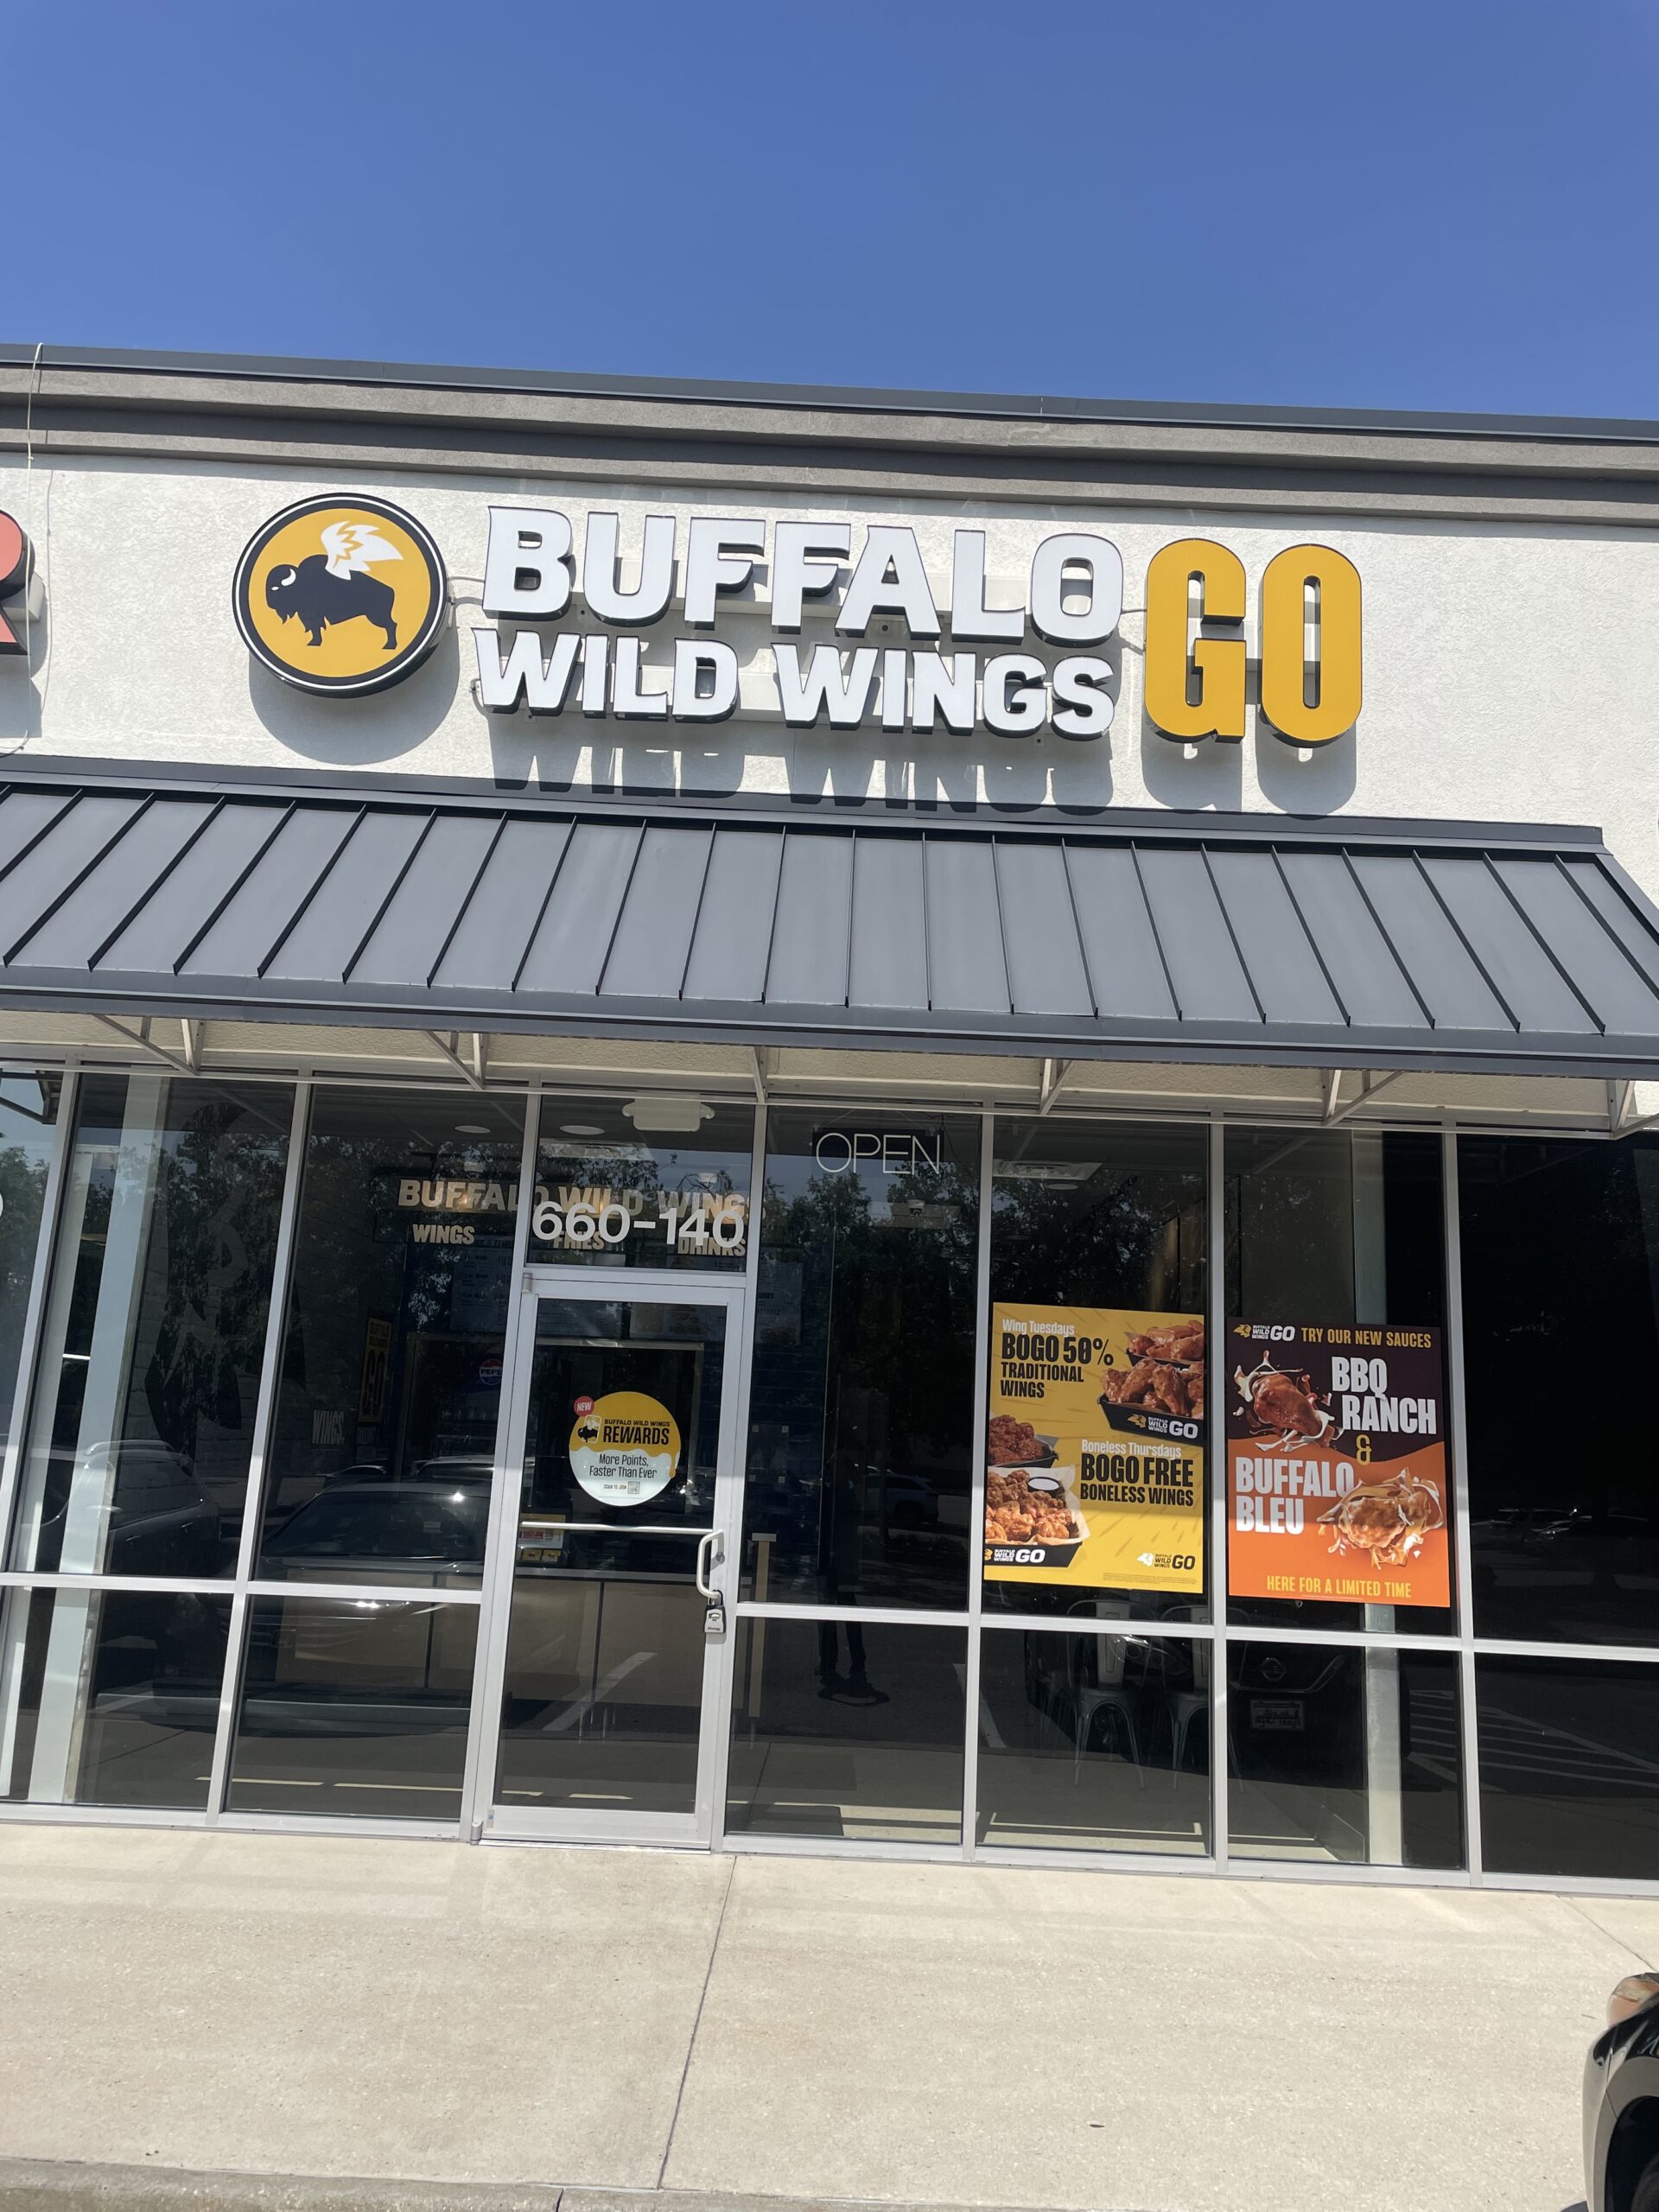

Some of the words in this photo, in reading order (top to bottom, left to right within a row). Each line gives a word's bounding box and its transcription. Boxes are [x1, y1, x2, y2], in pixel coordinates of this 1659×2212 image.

[482, 505, 1123, 646] BUFFALO
[1145, 537, 1363, 747] GO
[471, 628, 738, 722] WILD
[772, 643, 1115, 741] WINGS
[816, 1133, 940, 1175] OPEN
[657, 1190, 766, 1220] WING
[413, 1224, 475, 1244] WINGS
[532, 1201, 744, 1249] 660-140
[1002, 1319, 1027, 1335] Wing
[1029, 1321, 1075, 1337] Tuesdays
[1270, 1325, 1295, 1341] GO
[1301, 1327, 1323, 1343] TRY
[1327, 1329, 1351, 1344] OUR
[1356, 1331, 1382, 1345] NEW
[1386, 1332, 1431, 1348] SAUCES
[1002, 1332, 1058, 1362] BOGO
[1064, 1337, 1114, 1365] 50%
[1001, 1362, 1084, 1382] TRADITIONAL
[1332, 1357, 1388, 1401] BBQ
[1001, 1380, 1045, 1398] WINGS
[577, 1402, 593, 1411] NEW
[1342, 1395, 1437, 1434] RANCH
[603, 1426, 670, 1445] REWARDS
[1169, 1421, 1198, 1439] GO
[600, 1453, 620, 1465] More
[622, 1455, 649, 1466] Points,
[1082, 1439, 1126, 1454] Boneless
[1128, 1442, 1182, 1460] Thursdays
[1357, 1434, 1372, 1465] &
[589, 1465, 616, 1477] Faster
[619, 1467, 638, 1478] Than
[639, 1468, 657, 1478] Ever
[1081, 1453, 1139, 1484] BOGO
[1143, 1457, 1193, 1487] FREE
[1236, 1457, 1354, 1497] BUFFALO
[1080, 1483, 1145, 1503] BONELESS
[1148, 1487, 1193, 1506] WINGS
[1236, 1496, 1304, 1535] BLEU
[1015, 1548, 1046, 1563] GO
[1173, 1554, 1196, 1570] GO
[1267, 1575, 1295, 1592] HERE
[1300, 1577, 1321, 1593] FOR
[1325, 1578, 1332, 1593] A
[1336, 1579, 1381, 1596] LIMITED
[1384, 1581, 1411, 1598] TIME
